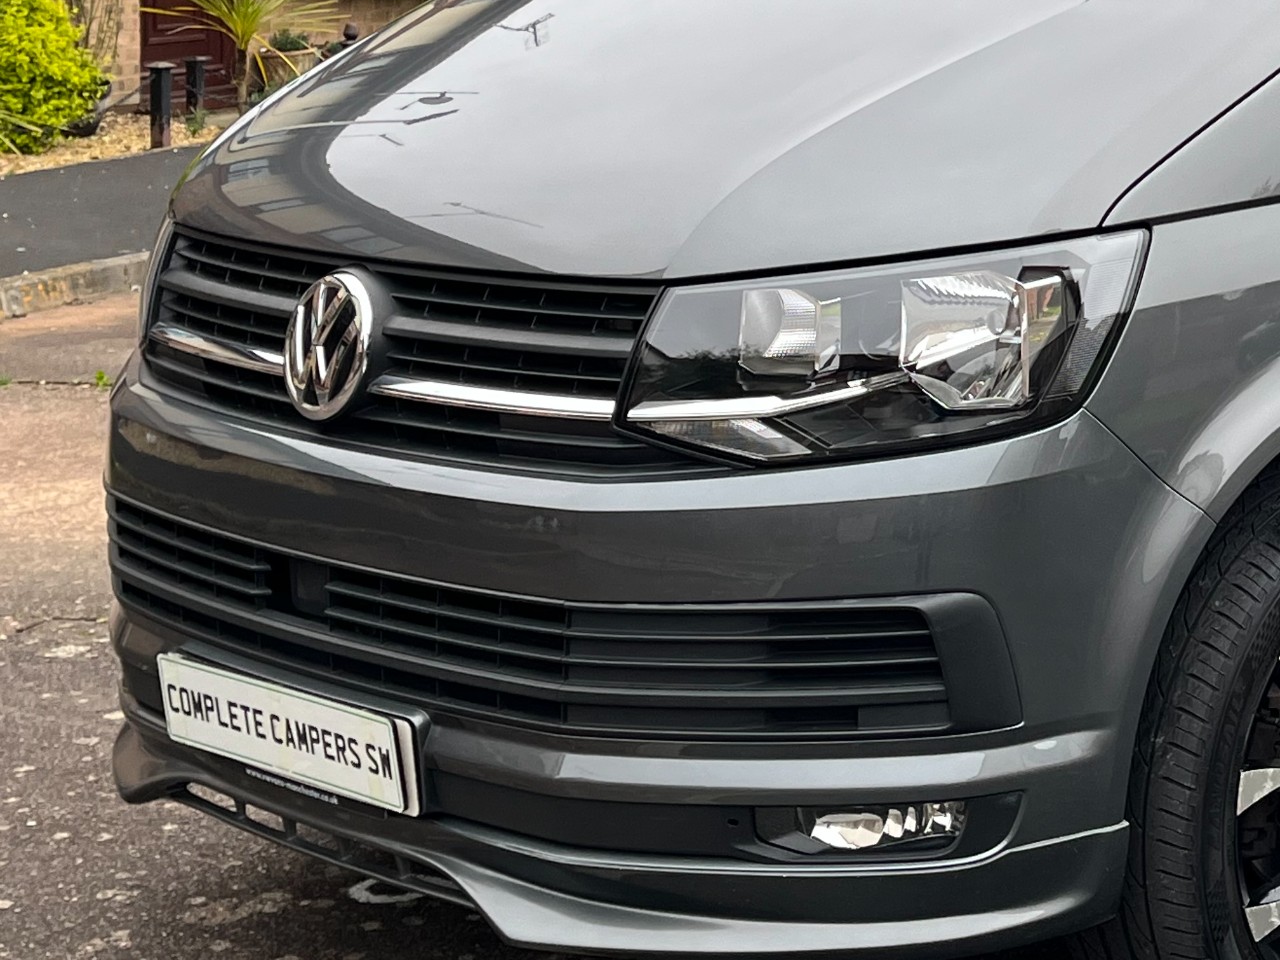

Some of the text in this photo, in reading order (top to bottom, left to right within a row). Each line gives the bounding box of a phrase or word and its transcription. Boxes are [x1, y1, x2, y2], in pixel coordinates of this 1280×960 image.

[166, 683, 393, 780] COMPLETE CAMPERS SW
